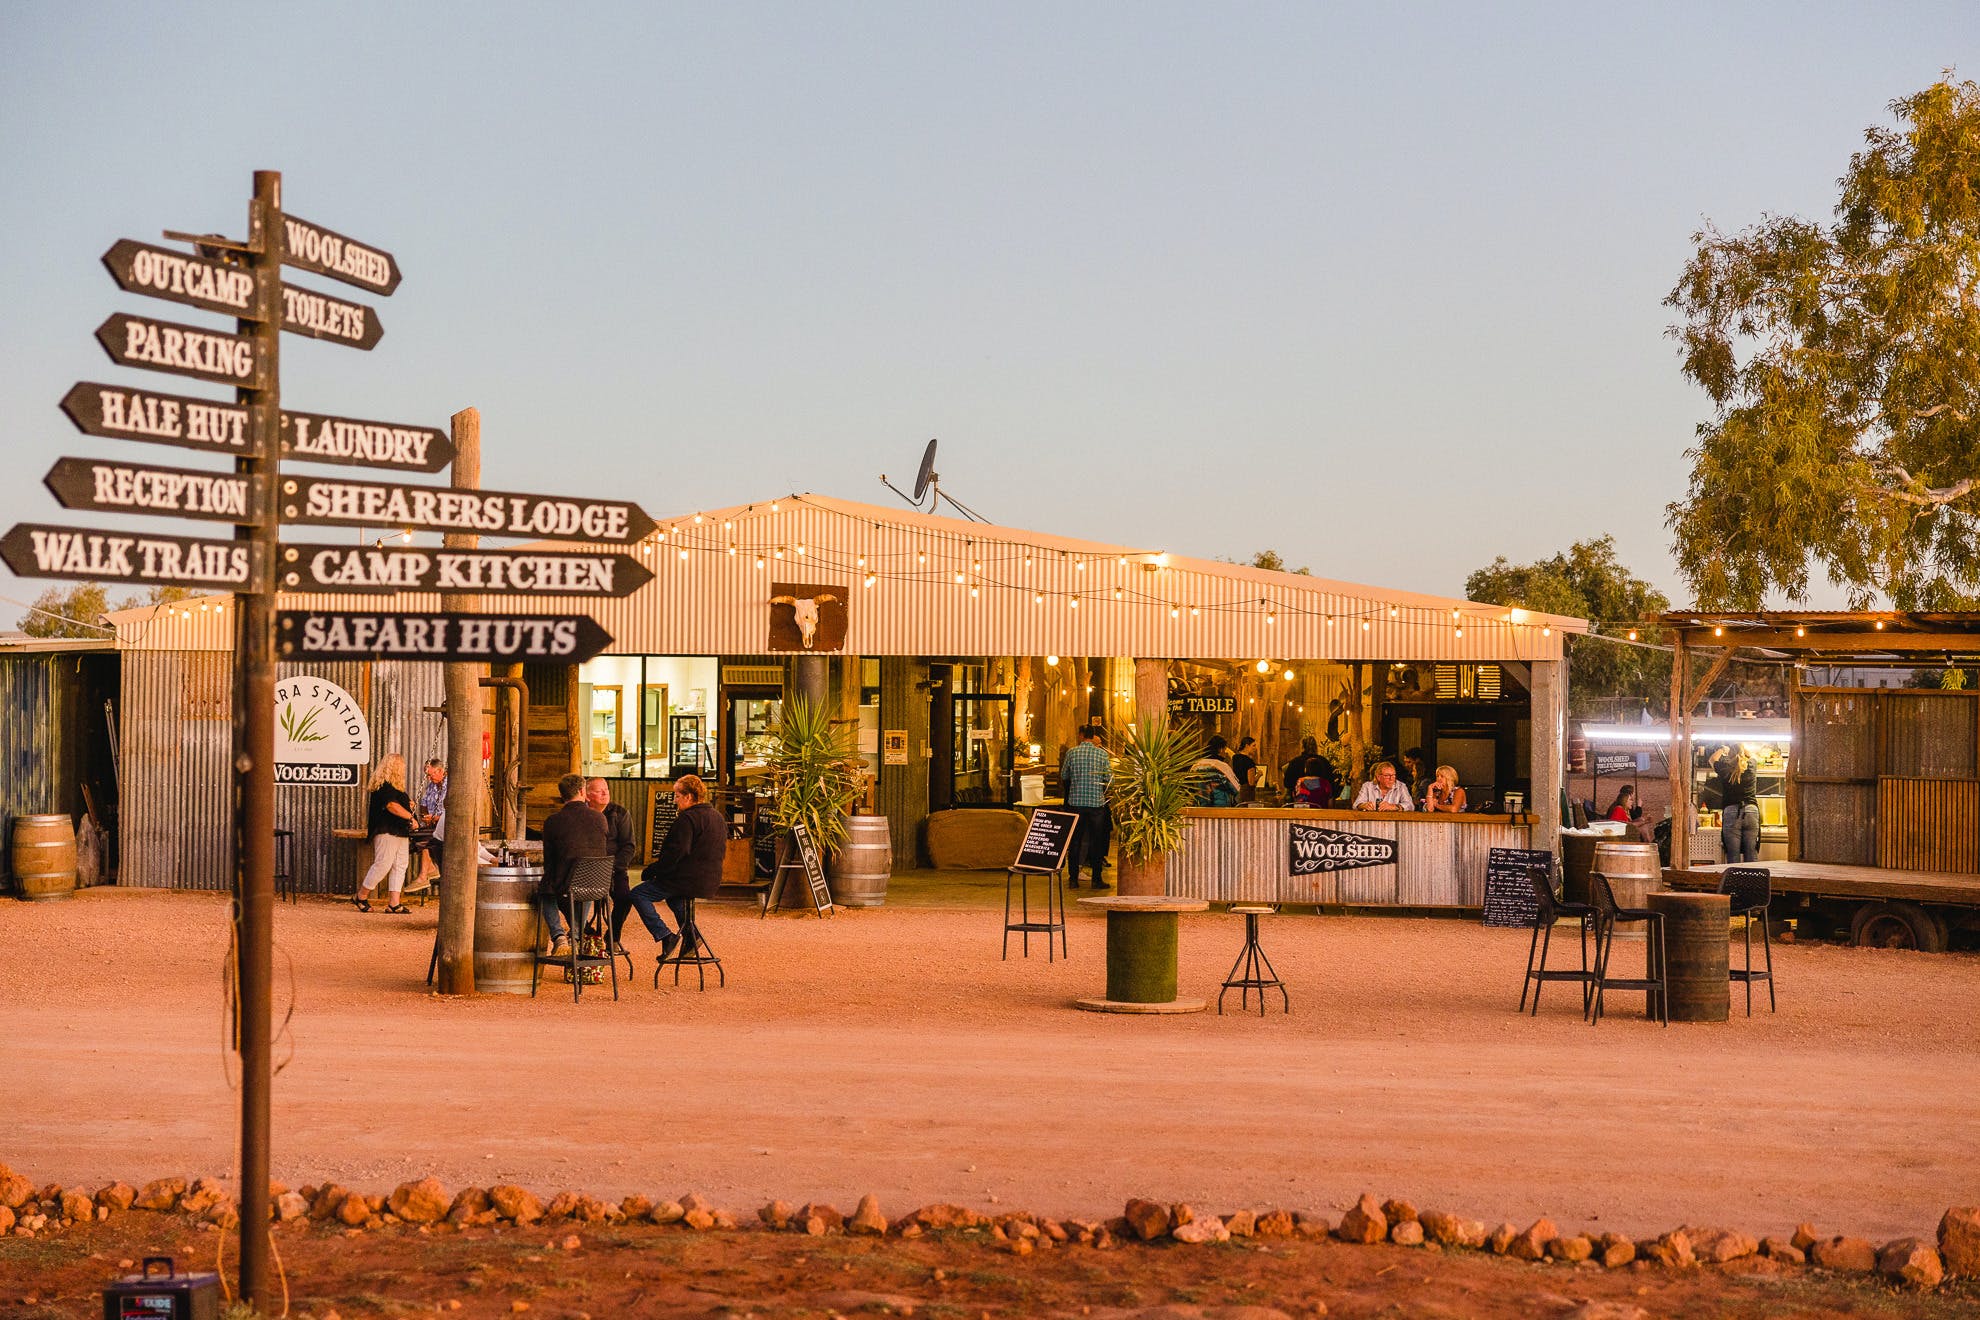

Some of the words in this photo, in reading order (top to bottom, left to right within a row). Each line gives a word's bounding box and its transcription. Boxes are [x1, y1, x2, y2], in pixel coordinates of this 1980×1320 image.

[133, 249, 255, 308] OUTCAMP
[285, 220, 391, 287] WOOLSHED
[283, 288, 365, 341] TOILETS
[124, 320, 254, 378] PARKING
[99, 390, 182, 438] HALE
[186, 403, 248, 446] HUT
[294, 417, 434, 466] LAUNDRY
[92, 466, 248, 517] RECEPTION
[306, 482, 506, 532] SHEARERS
[508, 498, 630, 540] LODGE
[30, 530, 134, 577] WALK
[137, 540, 249, 583] TRAILS
[310, 550, 432, 587] CAMP
[435, 553, 616, 592] KITCHEN
[303, 616, 450, 653] SAFARI
[457, 619, 578, 655] HUTS
[274, 684, 302, 705] RA
[311, 685, 362, 750] STATION
[1187, 697, 1234, 712] TABLE
[1293, 840, 1393, 859] WOOLSHED
